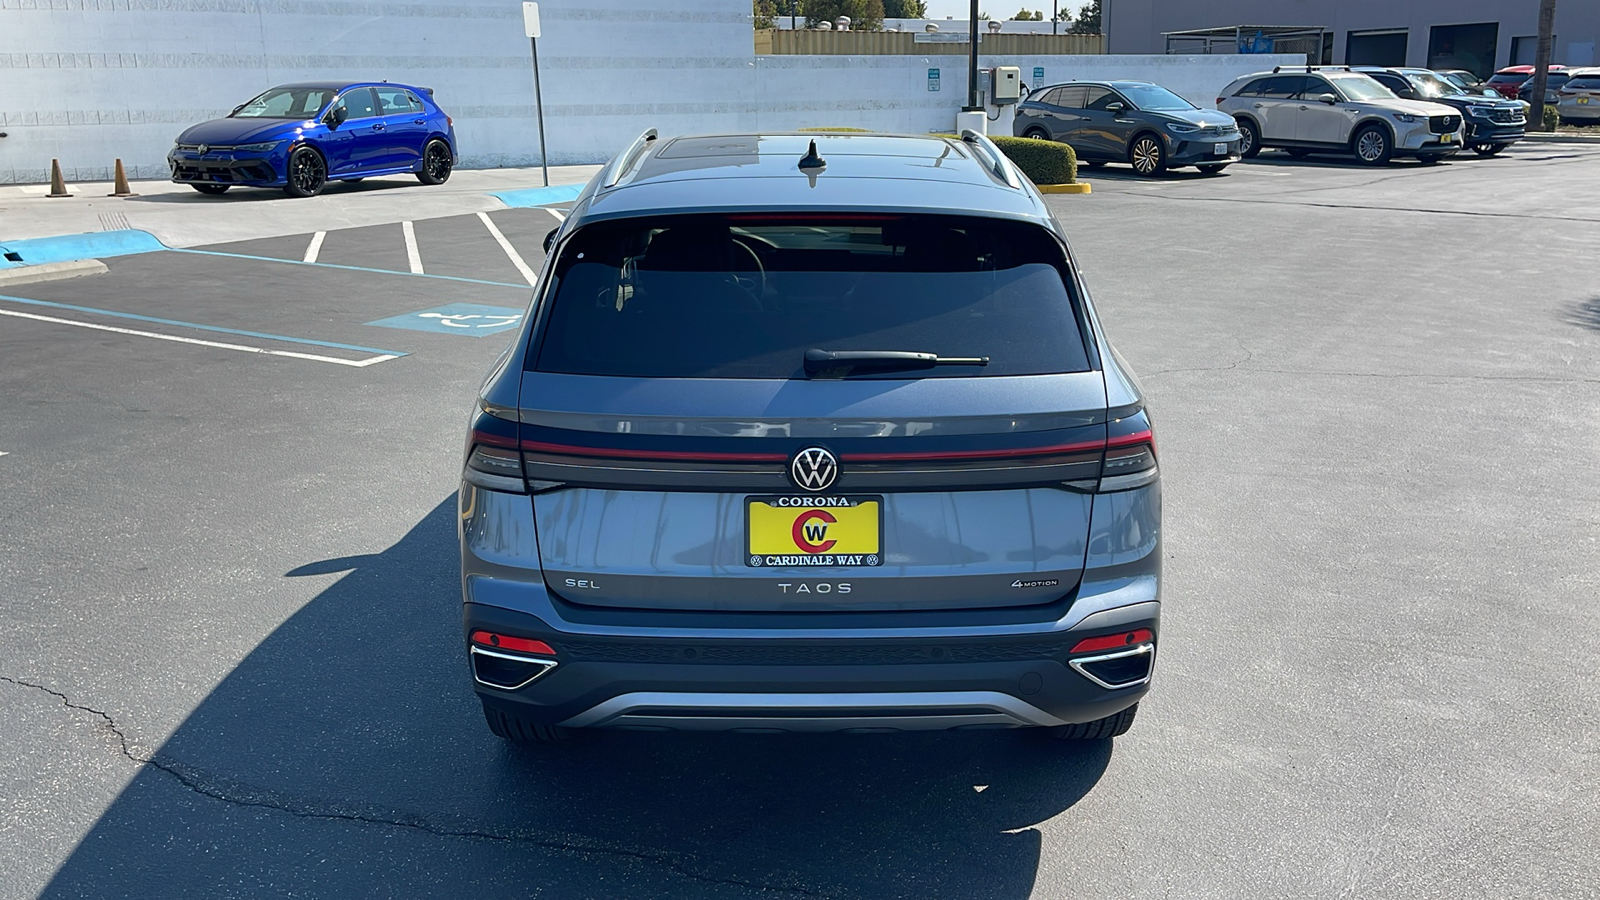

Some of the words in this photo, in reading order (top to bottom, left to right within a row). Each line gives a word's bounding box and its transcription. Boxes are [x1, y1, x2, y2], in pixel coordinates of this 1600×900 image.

[793, 448, 837, 490] VW
[778, 497, 849, 507] CORONA
[766, 556, 833, 565] CARDINALE
[836, 555, 863, 565] WAY
[565, 578, 600, 589] SEL
[778, 583, 852, 594] TAOS
[1011, 579, 1058, 589] 4MOTION
